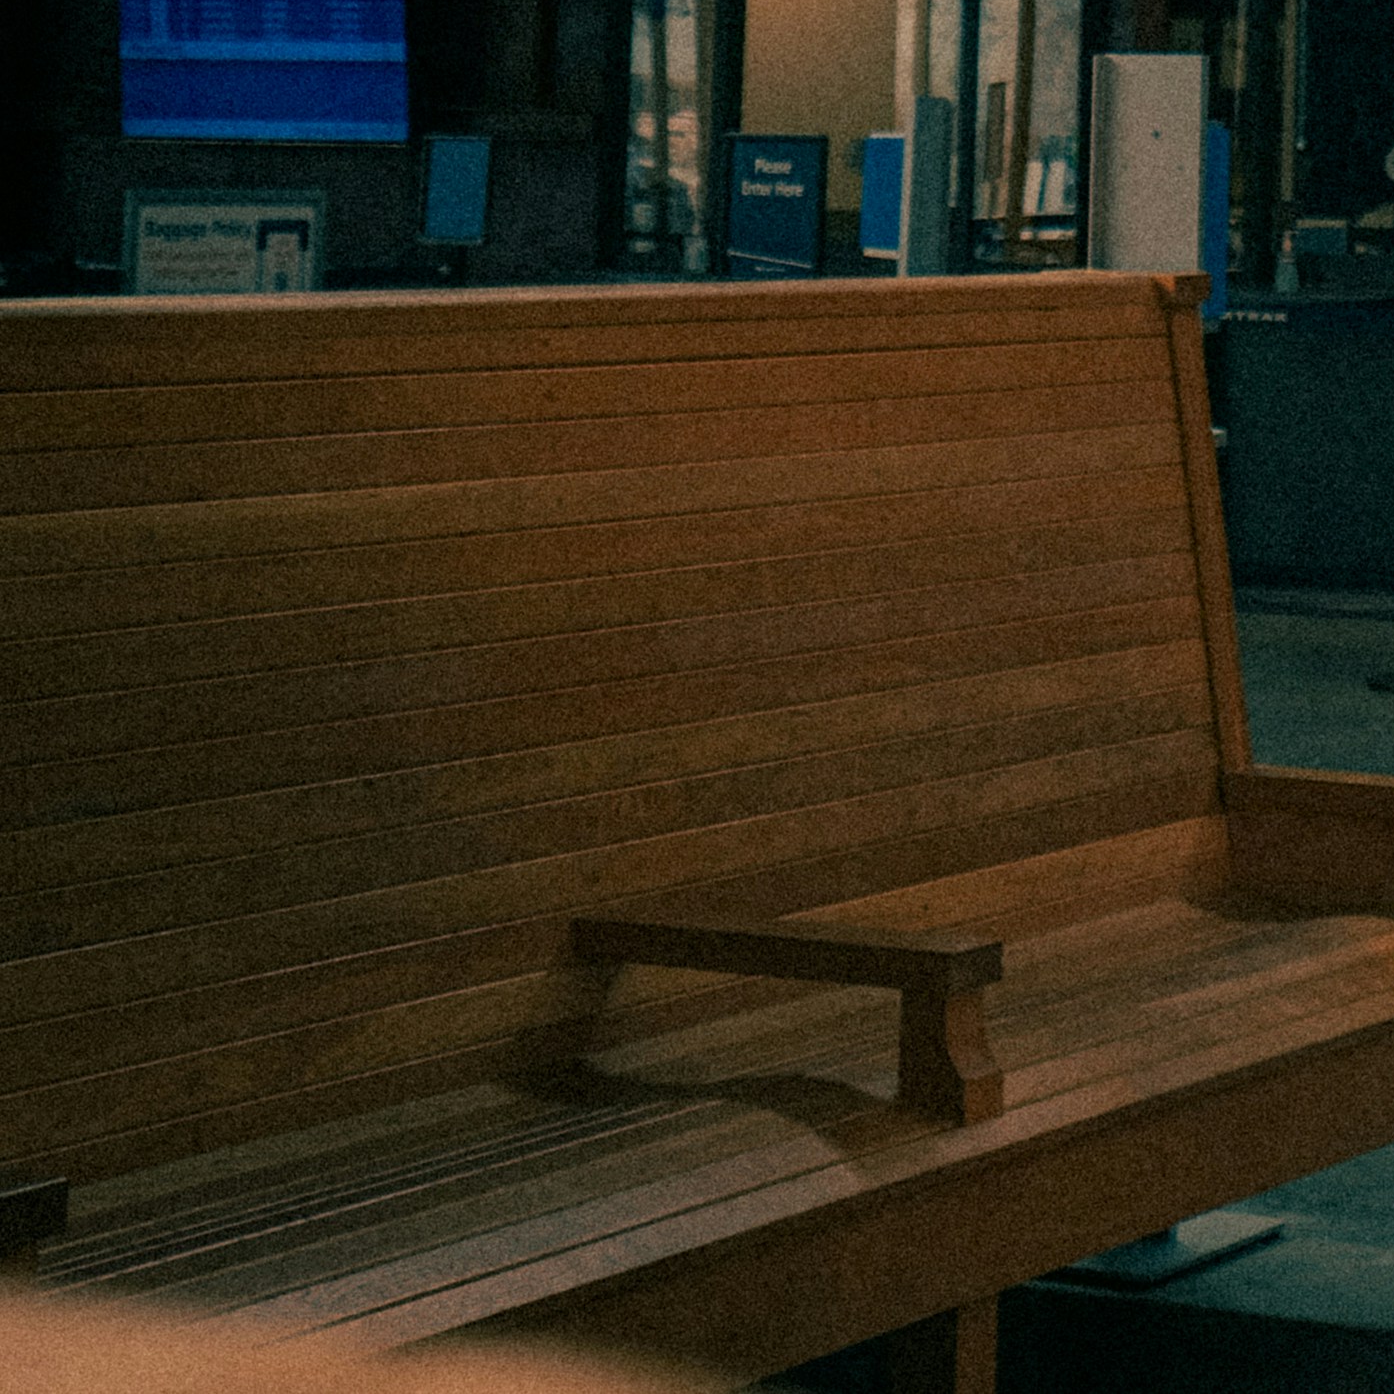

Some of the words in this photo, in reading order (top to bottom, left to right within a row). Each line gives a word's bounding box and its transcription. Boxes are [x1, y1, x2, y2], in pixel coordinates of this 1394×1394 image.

[754, 158, 792, 174] Please
[741, 181, 772, 196] Enter
[775, 182, 804, 197] Here
